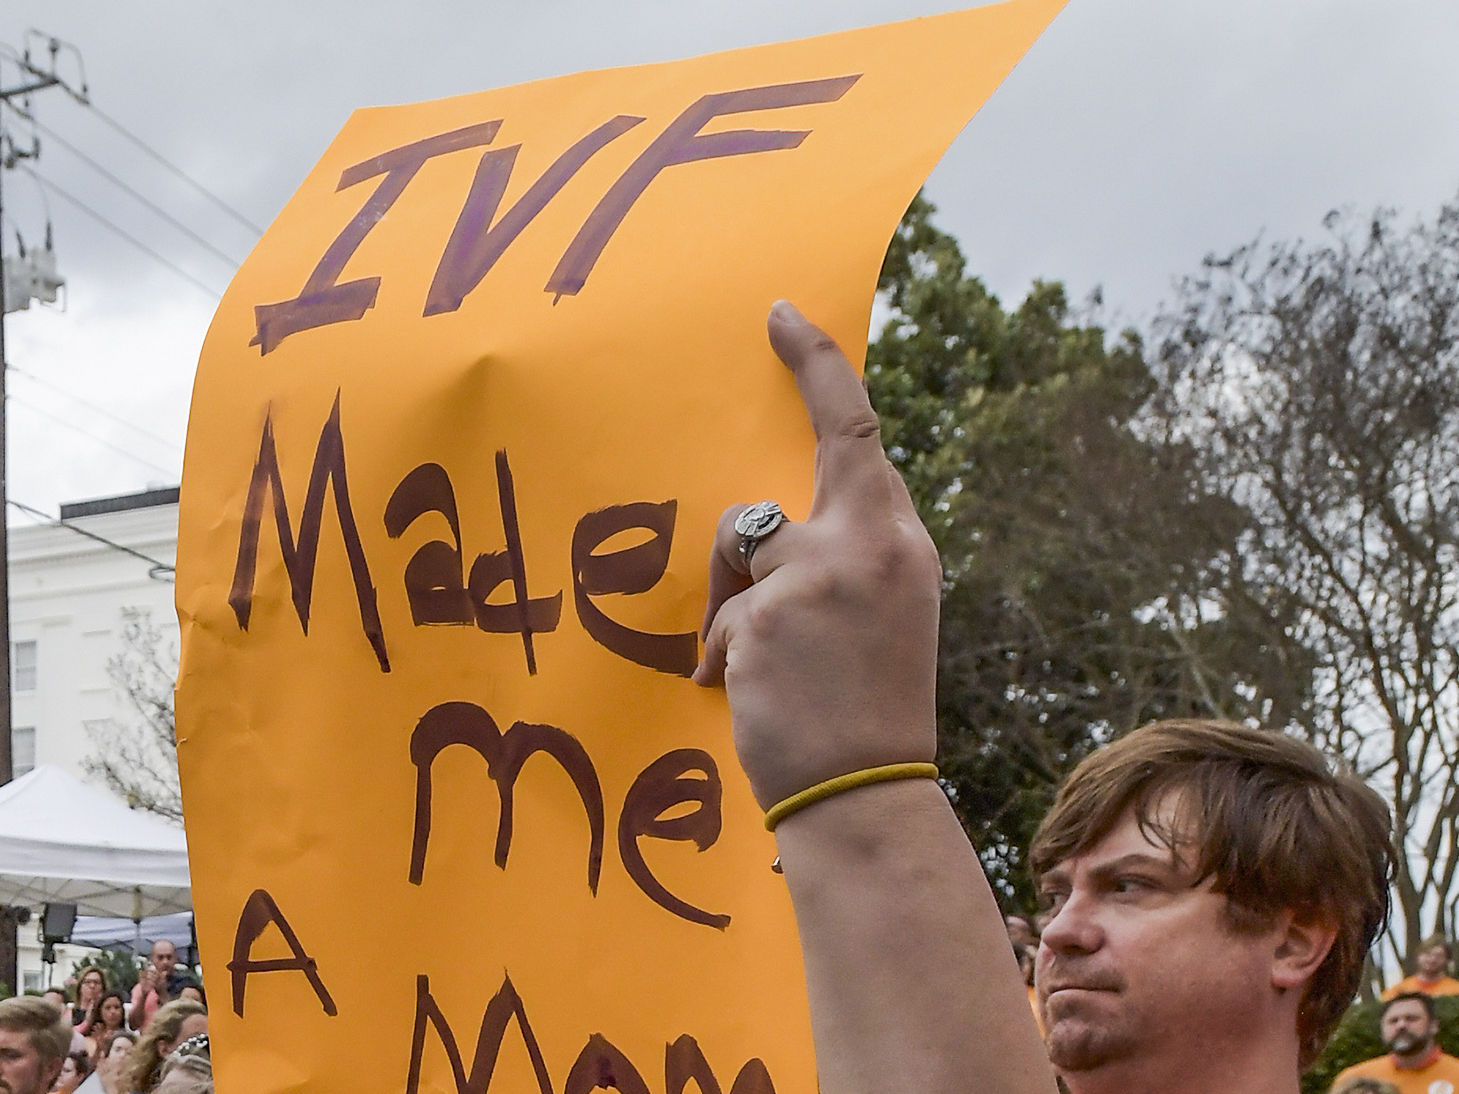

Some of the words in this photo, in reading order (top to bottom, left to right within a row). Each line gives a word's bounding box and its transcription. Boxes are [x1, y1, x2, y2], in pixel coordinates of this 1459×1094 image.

[249, 73, 864, 357] IVF
[227, 387, 700, 679] Made
[407, 701, 732, 932] me
[226, 888, 338, 1019] A
